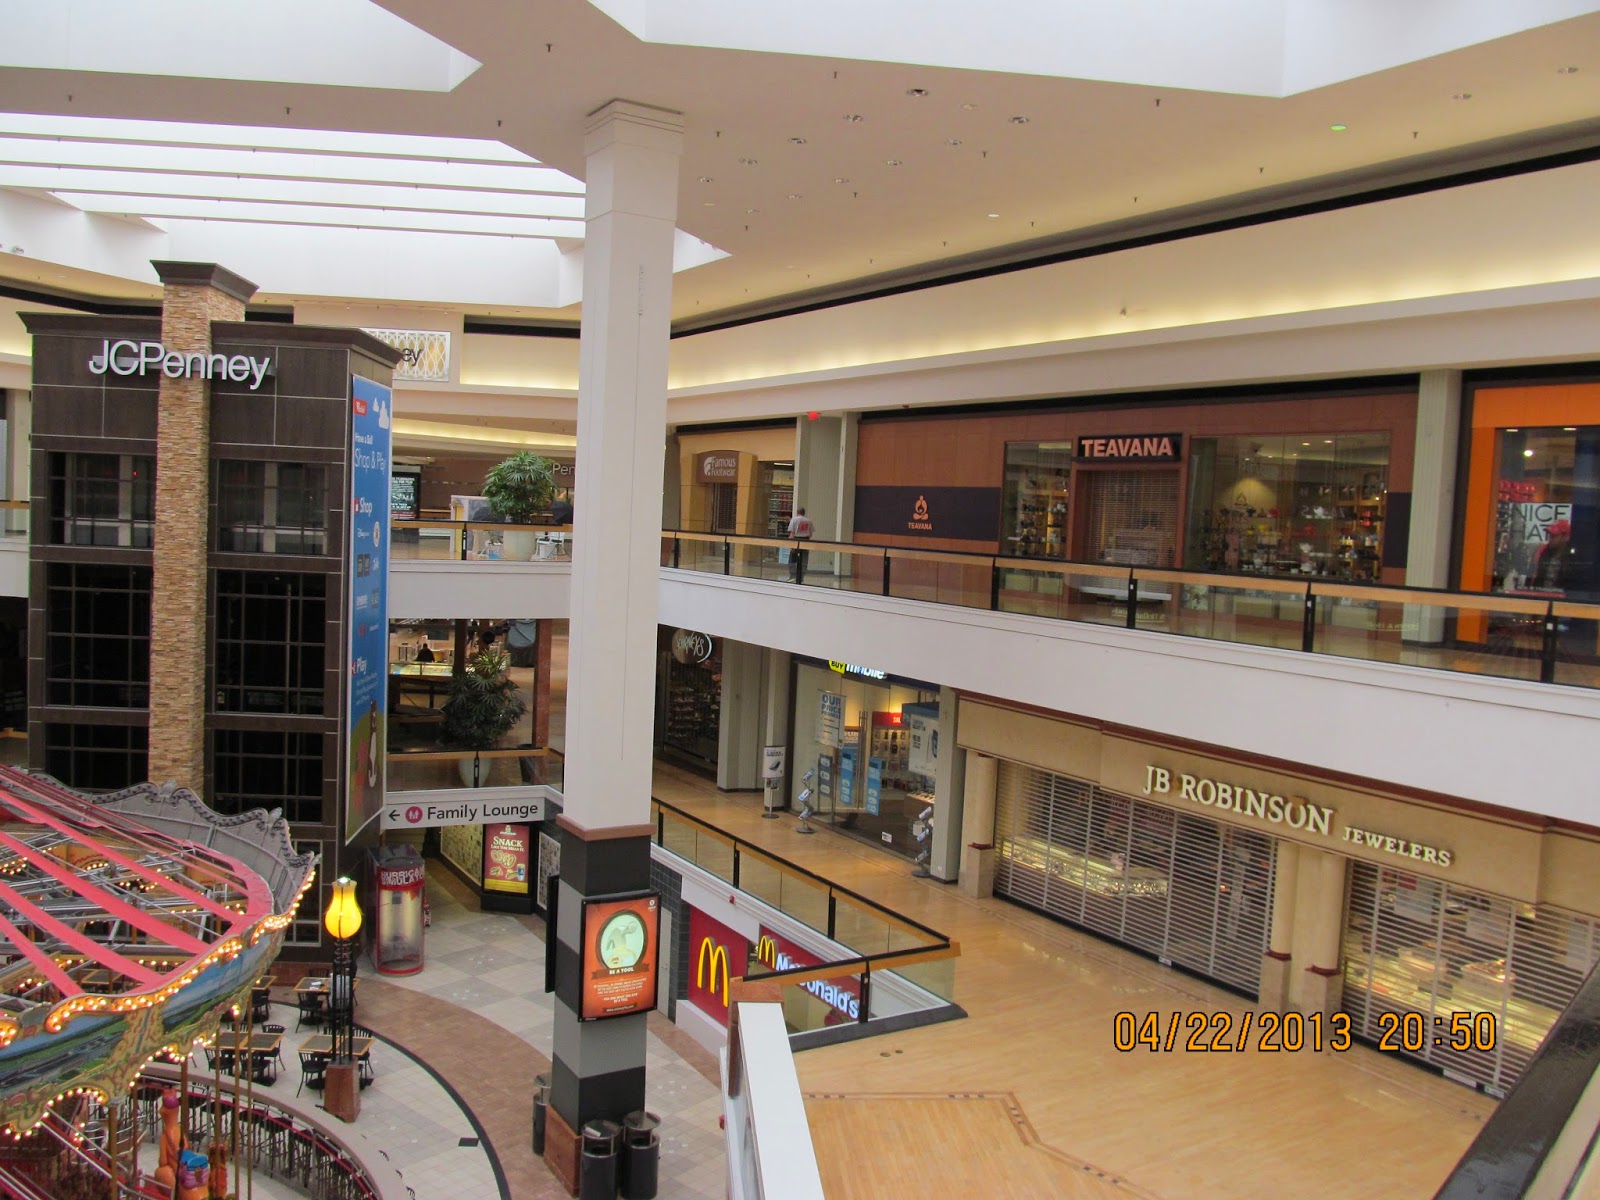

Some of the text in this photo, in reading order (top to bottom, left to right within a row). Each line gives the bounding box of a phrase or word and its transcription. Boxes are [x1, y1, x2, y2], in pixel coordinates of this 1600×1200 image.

[89, 340, 270, 390] JCPenney
[1082, 437, 1173, 458] TEAVANA
[355, 448, 370, 474] Shop
[711, 456, 736, 467] Famous
[711, 467, 736, 476] Footwear
[359, 496, 373, 517] Shop
[908, 521, 933, 531] TEAVANA
[427, 804, 538, 821] Family Lounge
[1143, 766, 1452, 867] JB ROBINSON JEWELERS
[493, 835, 523, 848] SNACK
